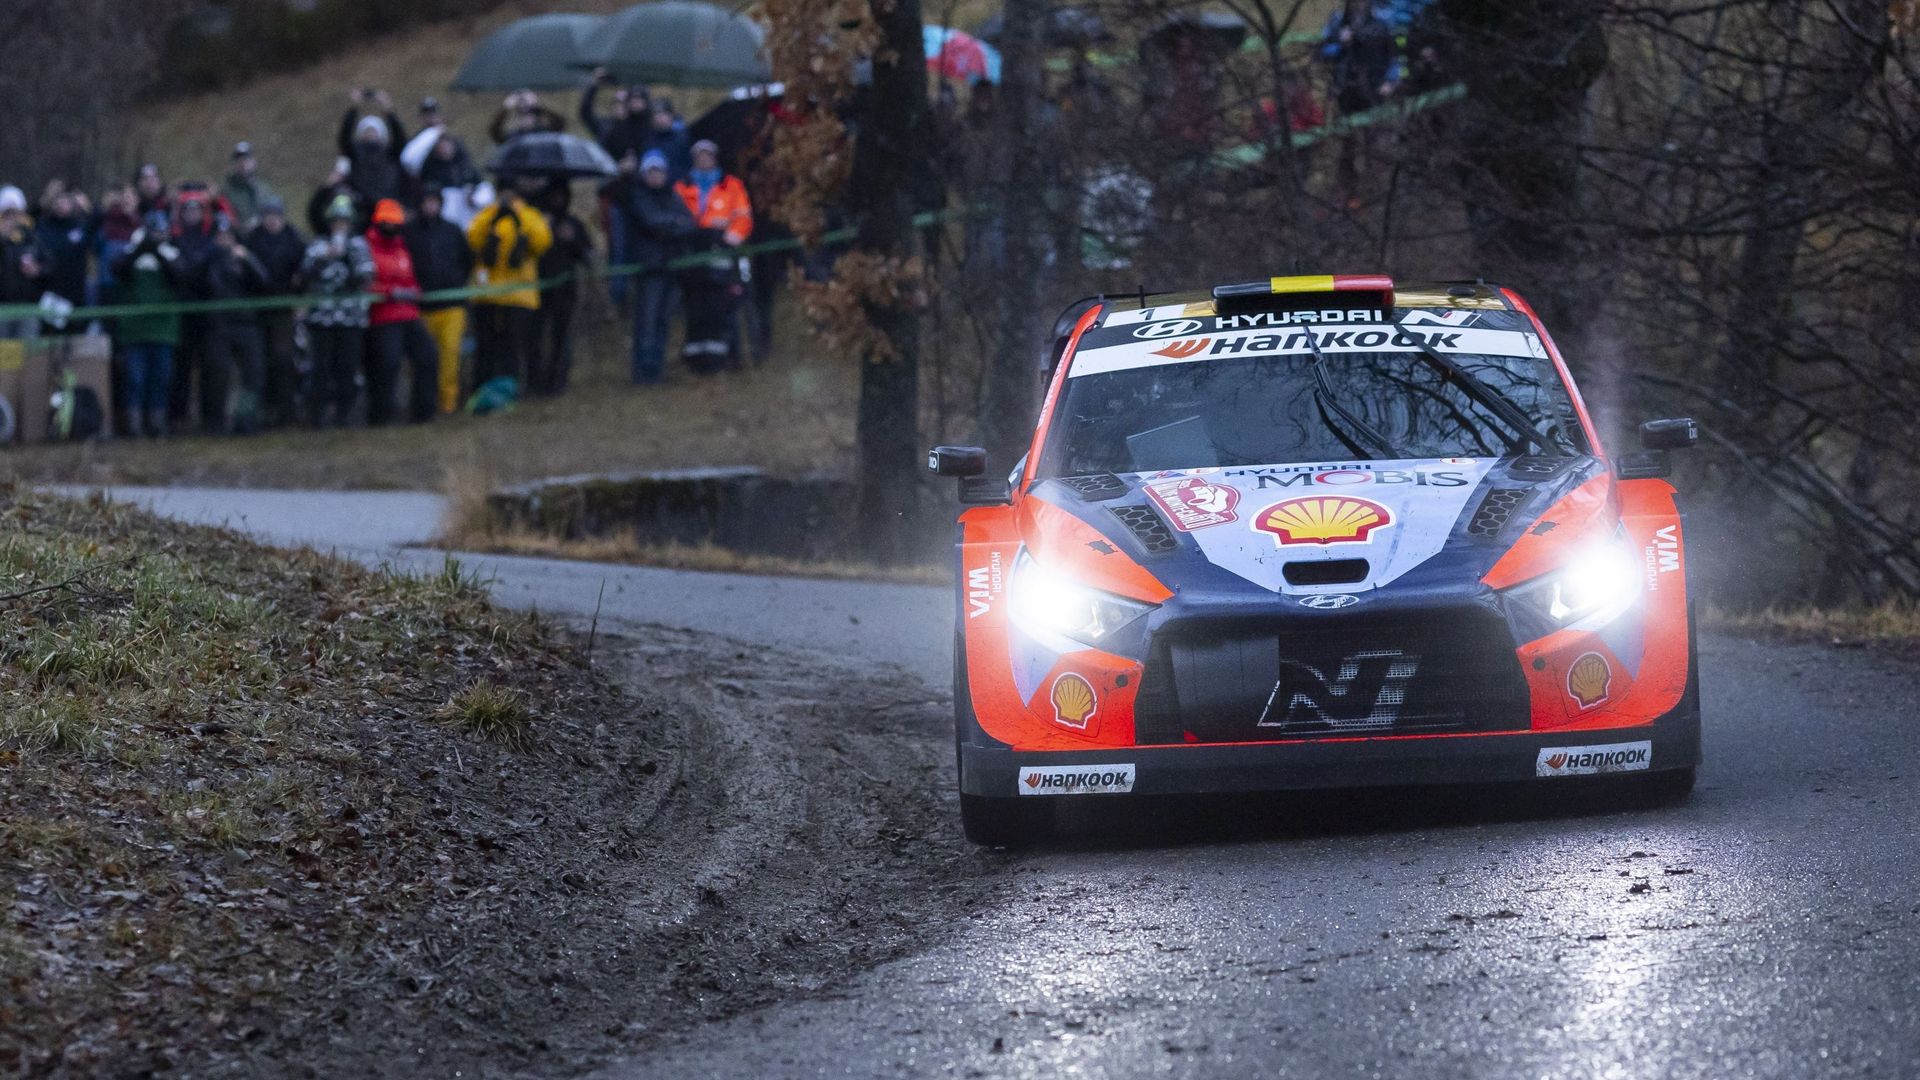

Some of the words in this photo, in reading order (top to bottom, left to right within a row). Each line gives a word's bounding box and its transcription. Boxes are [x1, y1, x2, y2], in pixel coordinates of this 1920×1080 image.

[1139, 307, 1156, 321] 1
[1215, 309, 1383, 329] HYUNDAI
[1224, 464, 1372, 477] HYUNDAI
[1257, 470, 1469, 489] MOBIS
[991, 551, 1002, 593] HYUNDAI
[1645, 546, 1659, 591] HYUNDAI
